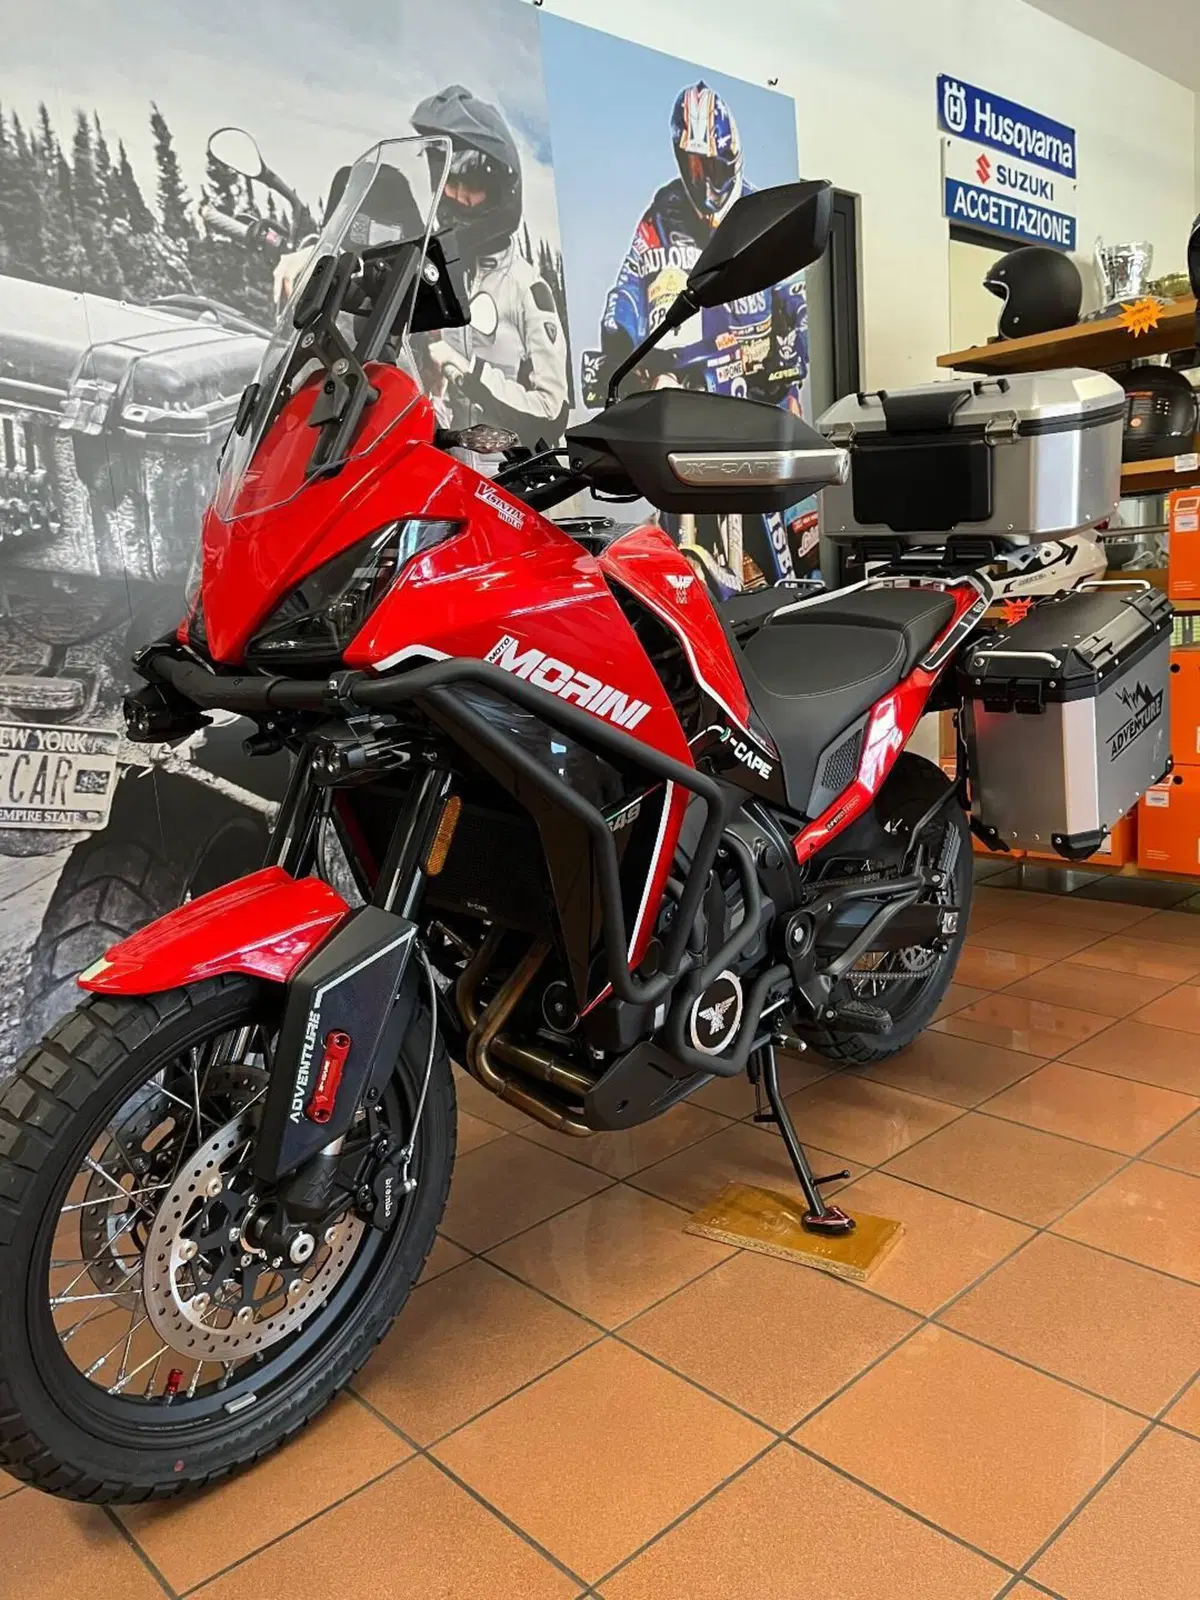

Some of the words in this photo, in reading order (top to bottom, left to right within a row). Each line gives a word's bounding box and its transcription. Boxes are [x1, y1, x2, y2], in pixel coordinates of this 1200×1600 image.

[974, 98, 1073, 169] Husqvarna
[996, 165, 1054, 201] SUZUKI
[953, 186, 1071, 245] ACCETTAZIONE
[684, 461, 779, 476] X-CAPE
[488, 637, 511, 662] MOTO
[499, 639, 652, 731] MORINI
[0, 727, 29, 749] EW
[36, 729, 88, 753] YORK
[1110, 696, 1163, 757] ADVENTURE
[0, 752, 72, 806] CAR
[0, 809, 42, 821] EMPIRE
[44, 811, 81, 822] STATE
[289, 1010, 321, 1124] ADVENTURE
[384, 1177, 394, 1217] brembo
